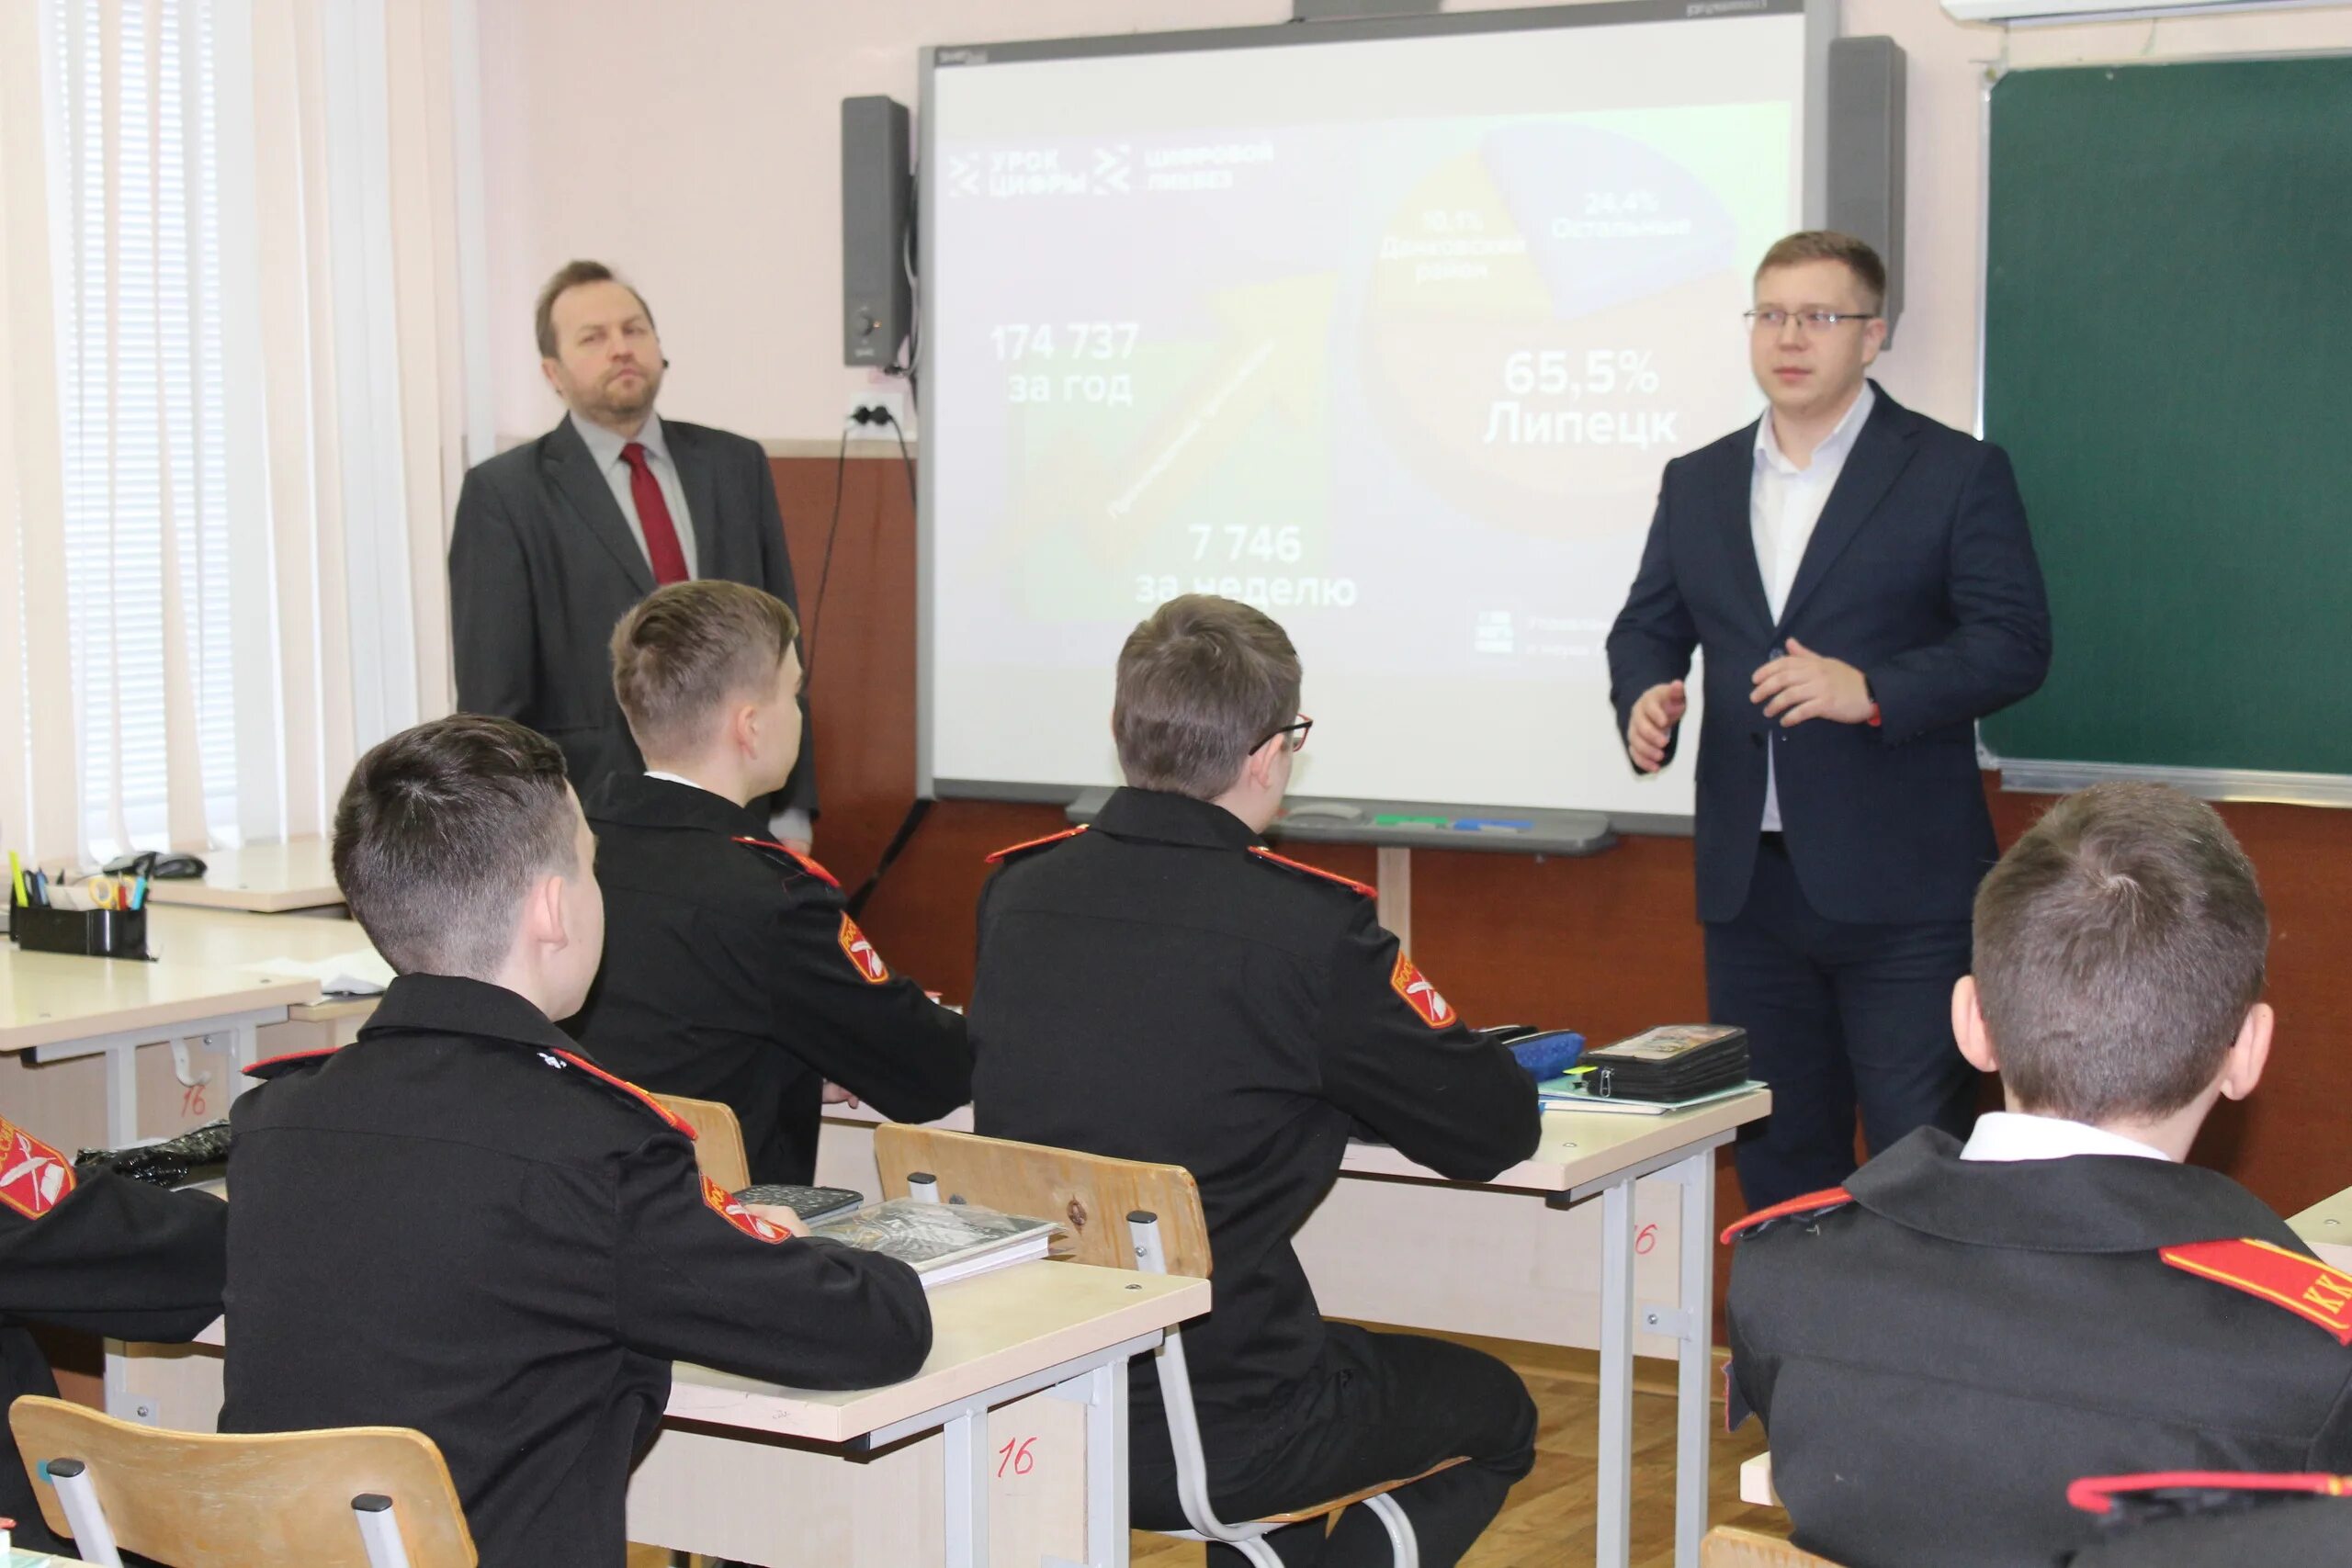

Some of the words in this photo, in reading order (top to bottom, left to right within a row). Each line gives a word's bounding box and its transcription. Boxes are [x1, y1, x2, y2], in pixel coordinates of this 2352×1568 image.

[989, 321, 1055, 361] 174
[1067, 321, 1140, 360] 737
[1007, 373, 1051, 403] за
[1063, 373, 1135, 407] год
[1504, 348, 1660, 400] 65,5%
[1484, 401, 1679, 449] Липецк
[1188, 524, 1212, 562] 7
[1224, 525, 1303, 564] 746
[1135, 574, 1179, 603] за
[181, 1084, 207, 1118] 16
[1634, 1223, 1658, 1255] 6
[998, 1437, 1038, 1478] 16
